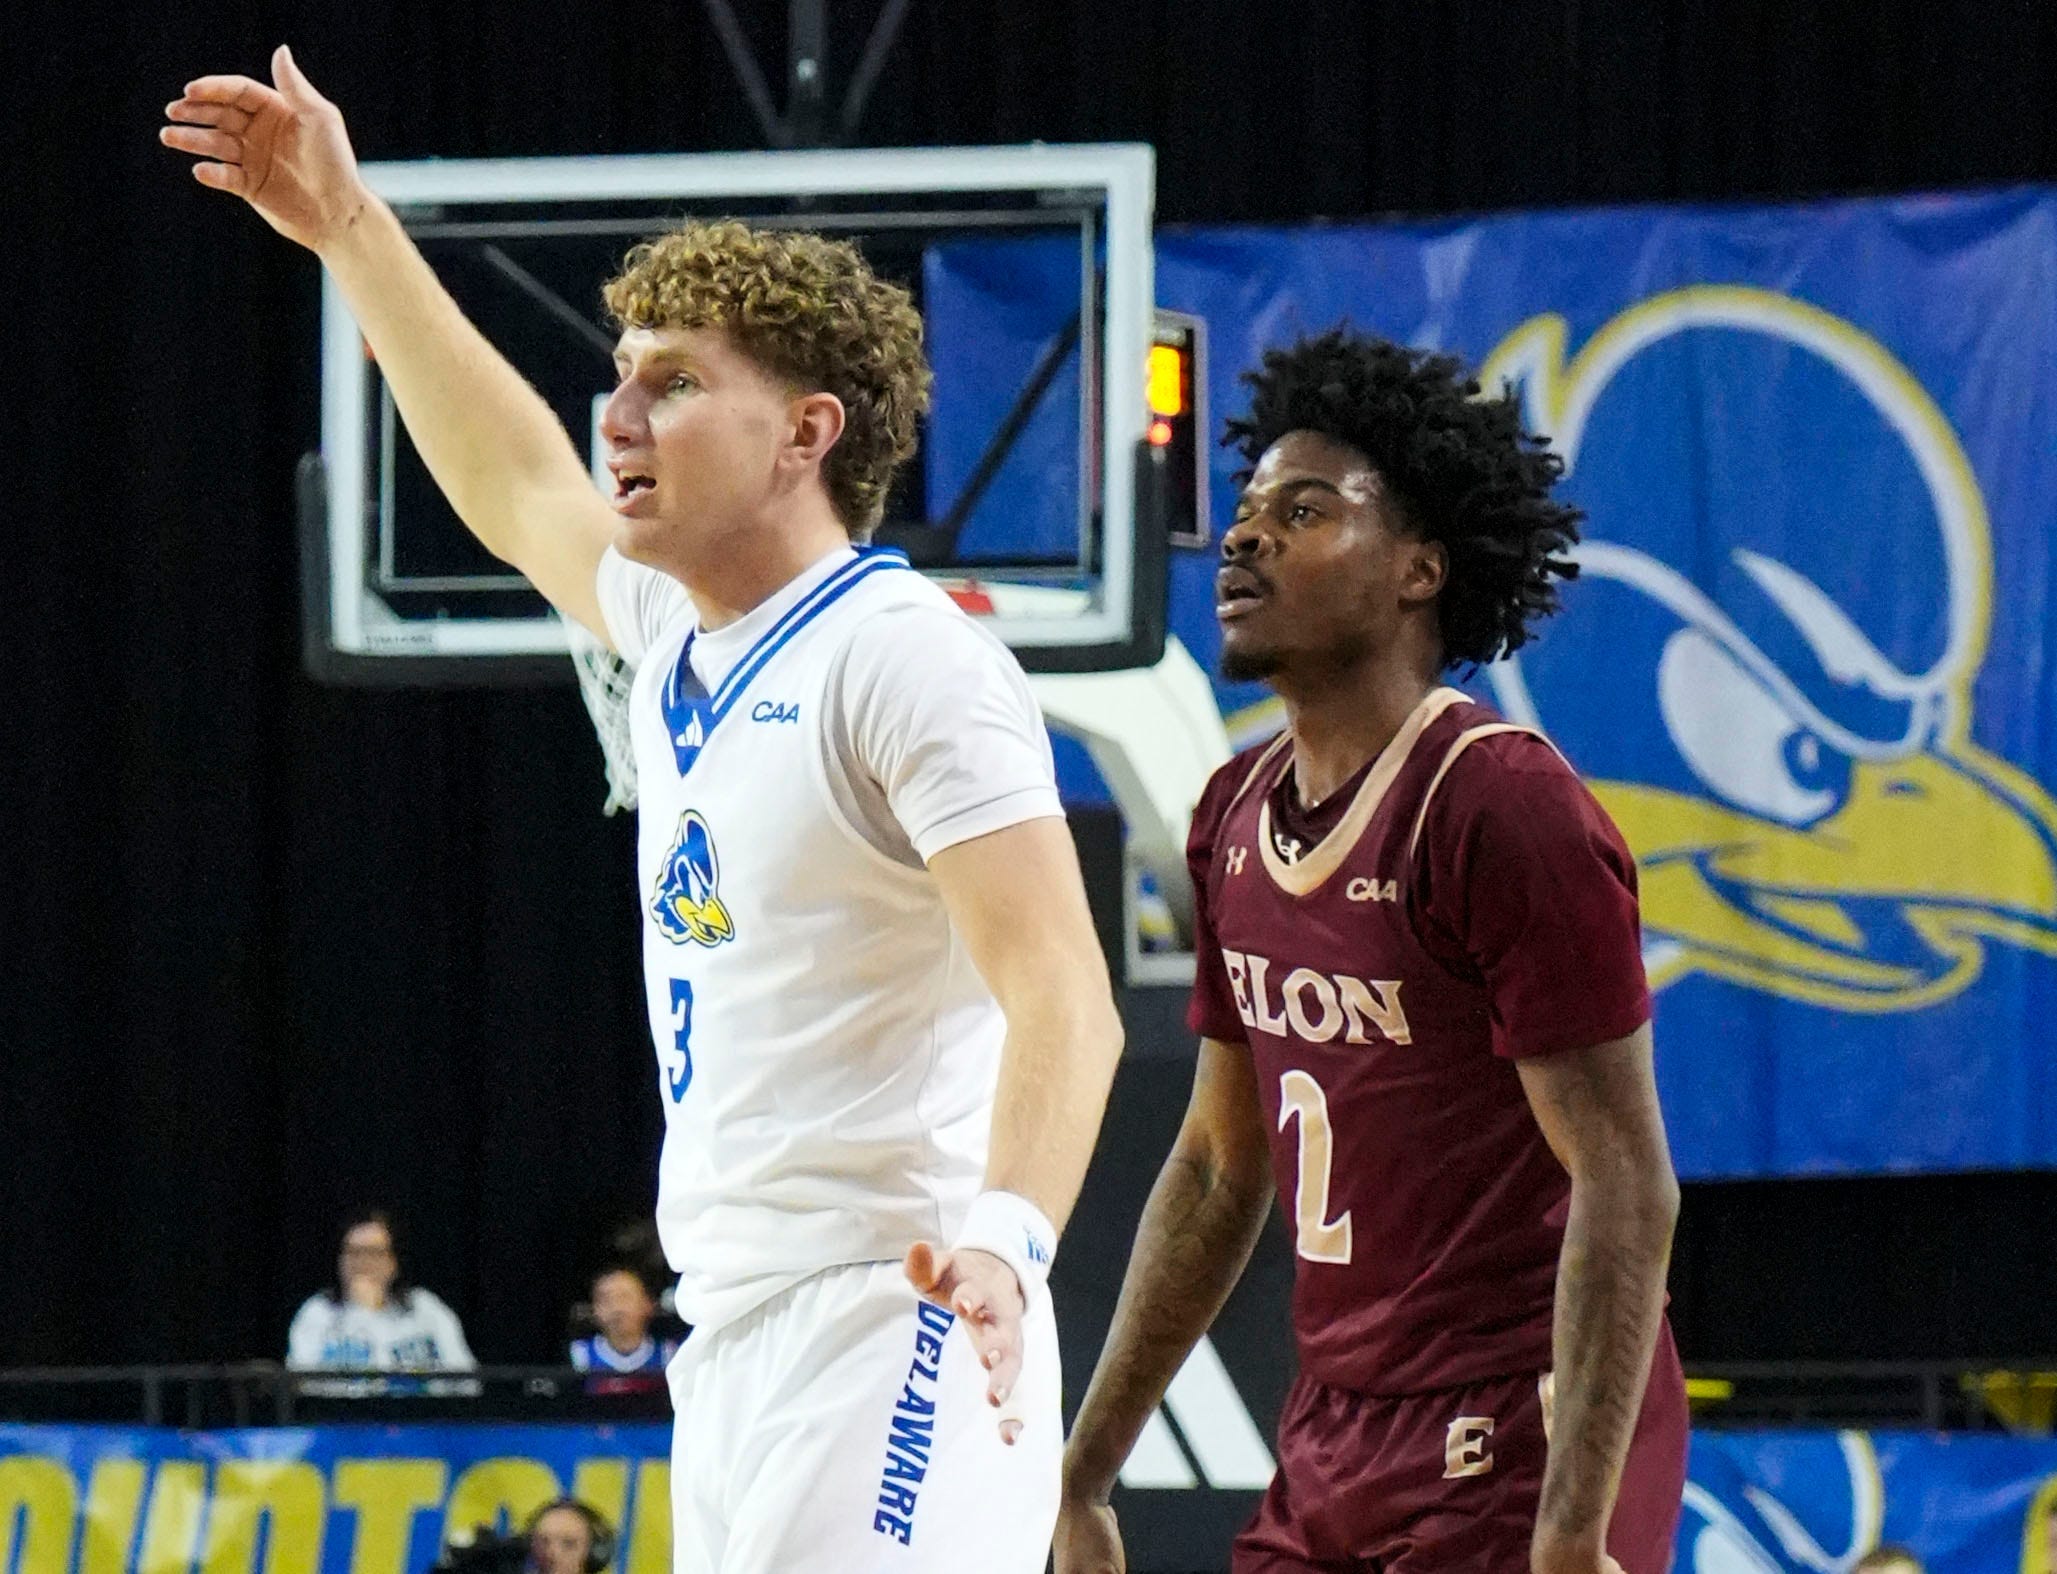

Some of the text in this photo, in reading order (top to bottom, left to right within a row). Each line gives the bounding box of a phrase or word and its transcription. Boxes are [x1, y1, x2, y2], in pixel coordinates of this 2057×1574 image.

[752, 700, 800, 724] CAA
[1345, 877, 1397, 903] CAA
[668, 977, 694, 1104] 3
[1221, 948, 1413, 1045] ELON
[1277, 1069, 1353, 1265] 2
[874, 1300, 956, 1546] DELAWARE
[1442, 1416, 1495, 1479] E
